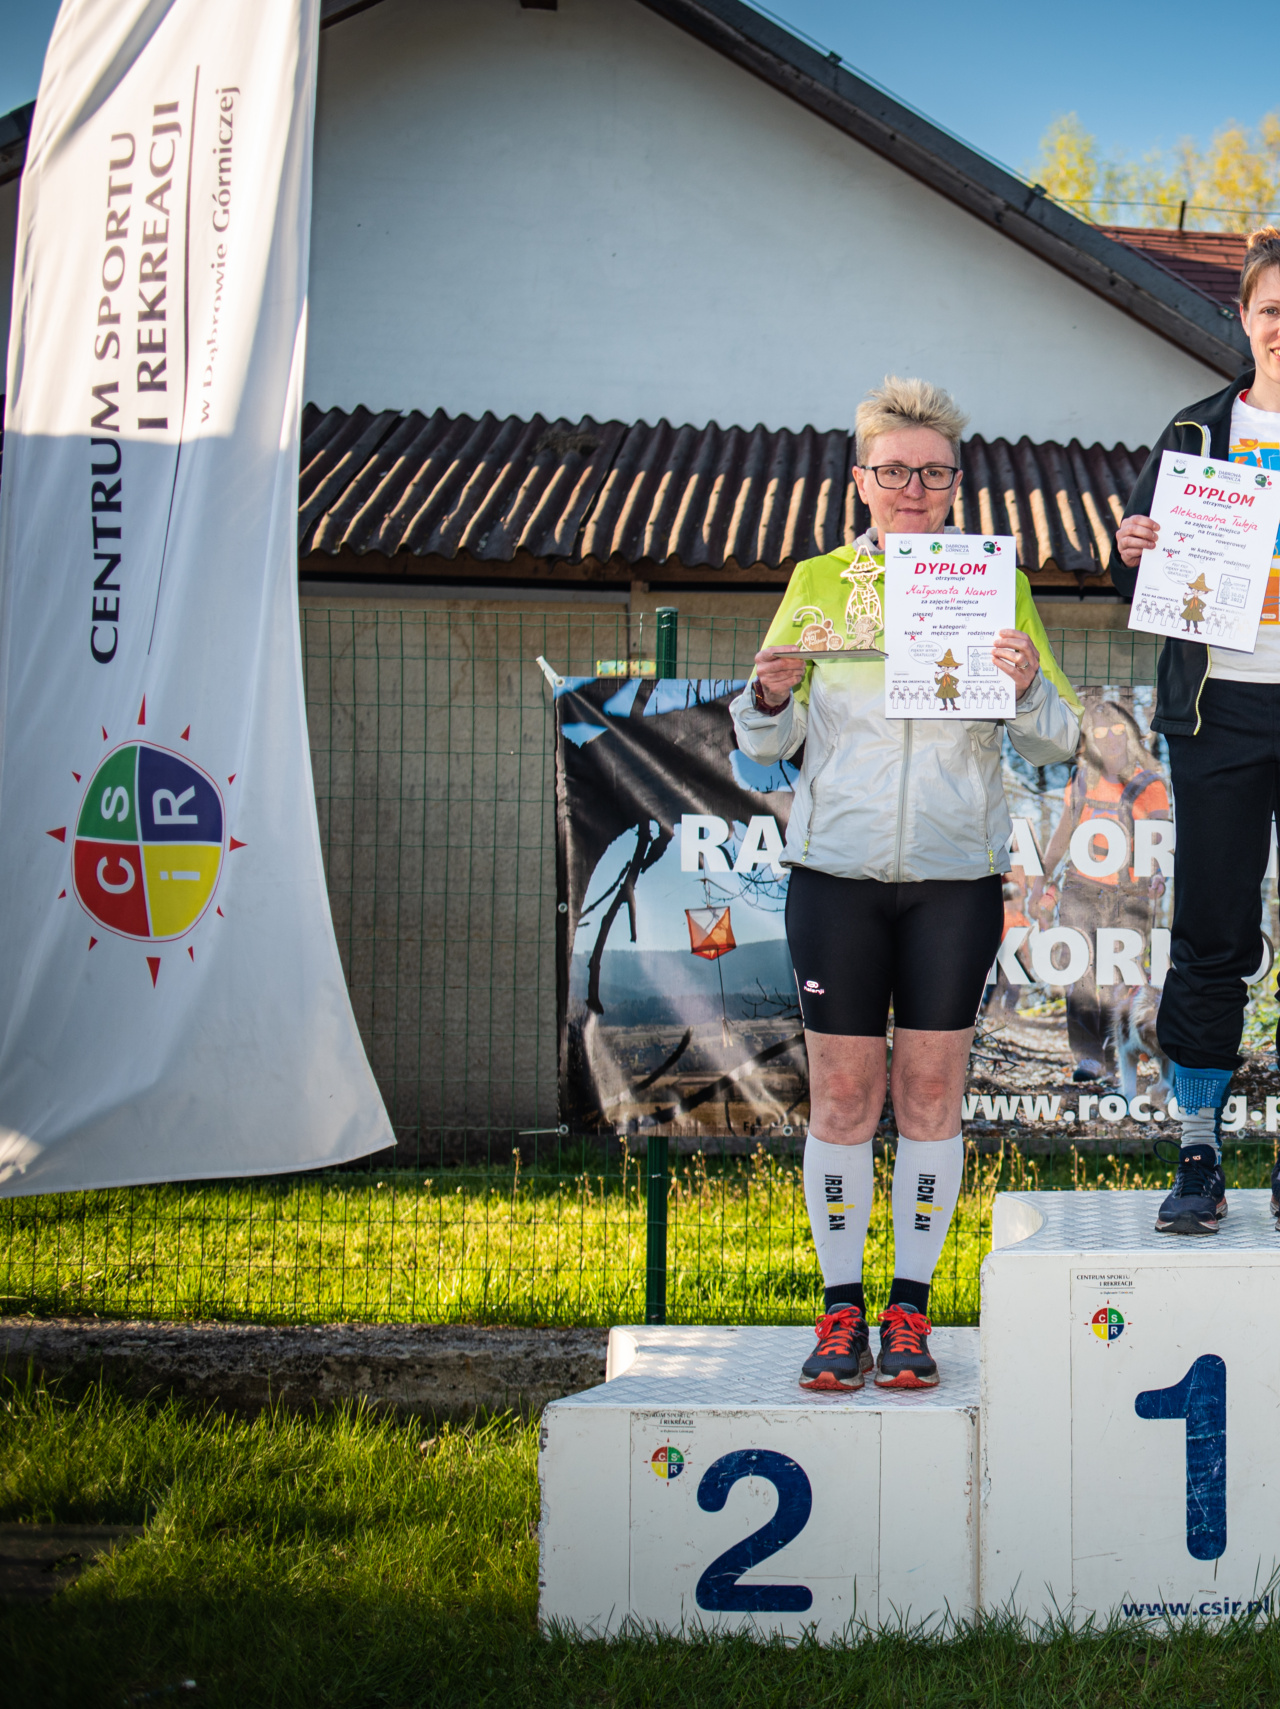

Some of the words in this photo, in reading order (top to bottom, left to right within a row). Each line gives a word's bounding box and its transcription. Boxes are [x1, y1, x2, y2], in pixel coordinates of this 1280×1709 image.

[93, 131, 137, 361] SPORTU
[137, 100, 183, 392] REKREACJI
[201, 400, 210, 424] w
[211, 86, 241, 233] Górniczej
[137, 417, 168, 431] I
[1184, 483, 1255, 507] DYPLOM
[1203, 500, 1232, 509] otrzymuje
[90, 383, 122, 665] CENTRUM
[1170, 506, 1226, 524] Aleksandra
[1174, 531, 1194, 539] pieszej
[1216, 540, 1246, 550] rowerowej
[914, 562, 987, 575] DYPLOM
[1188, 552, 1216, 562] mężczyzn
[1224, 560, 1250, 570] rodzinnej
[100, 786, 129, 822] S
[152, 785, 198, 824] R
[681, 814, 791, 873] RA
[97, 856, 135, 894] C
[825, 1174, 846, 1231] IRONMAN
[914, 1174, 936, 1232] IRONMAN
[1134, 1354, 1227, 1561] 1
[696, 1449, 813, 1612] 2
[1123, 1597, 1270, 1617] www.csir.pl
